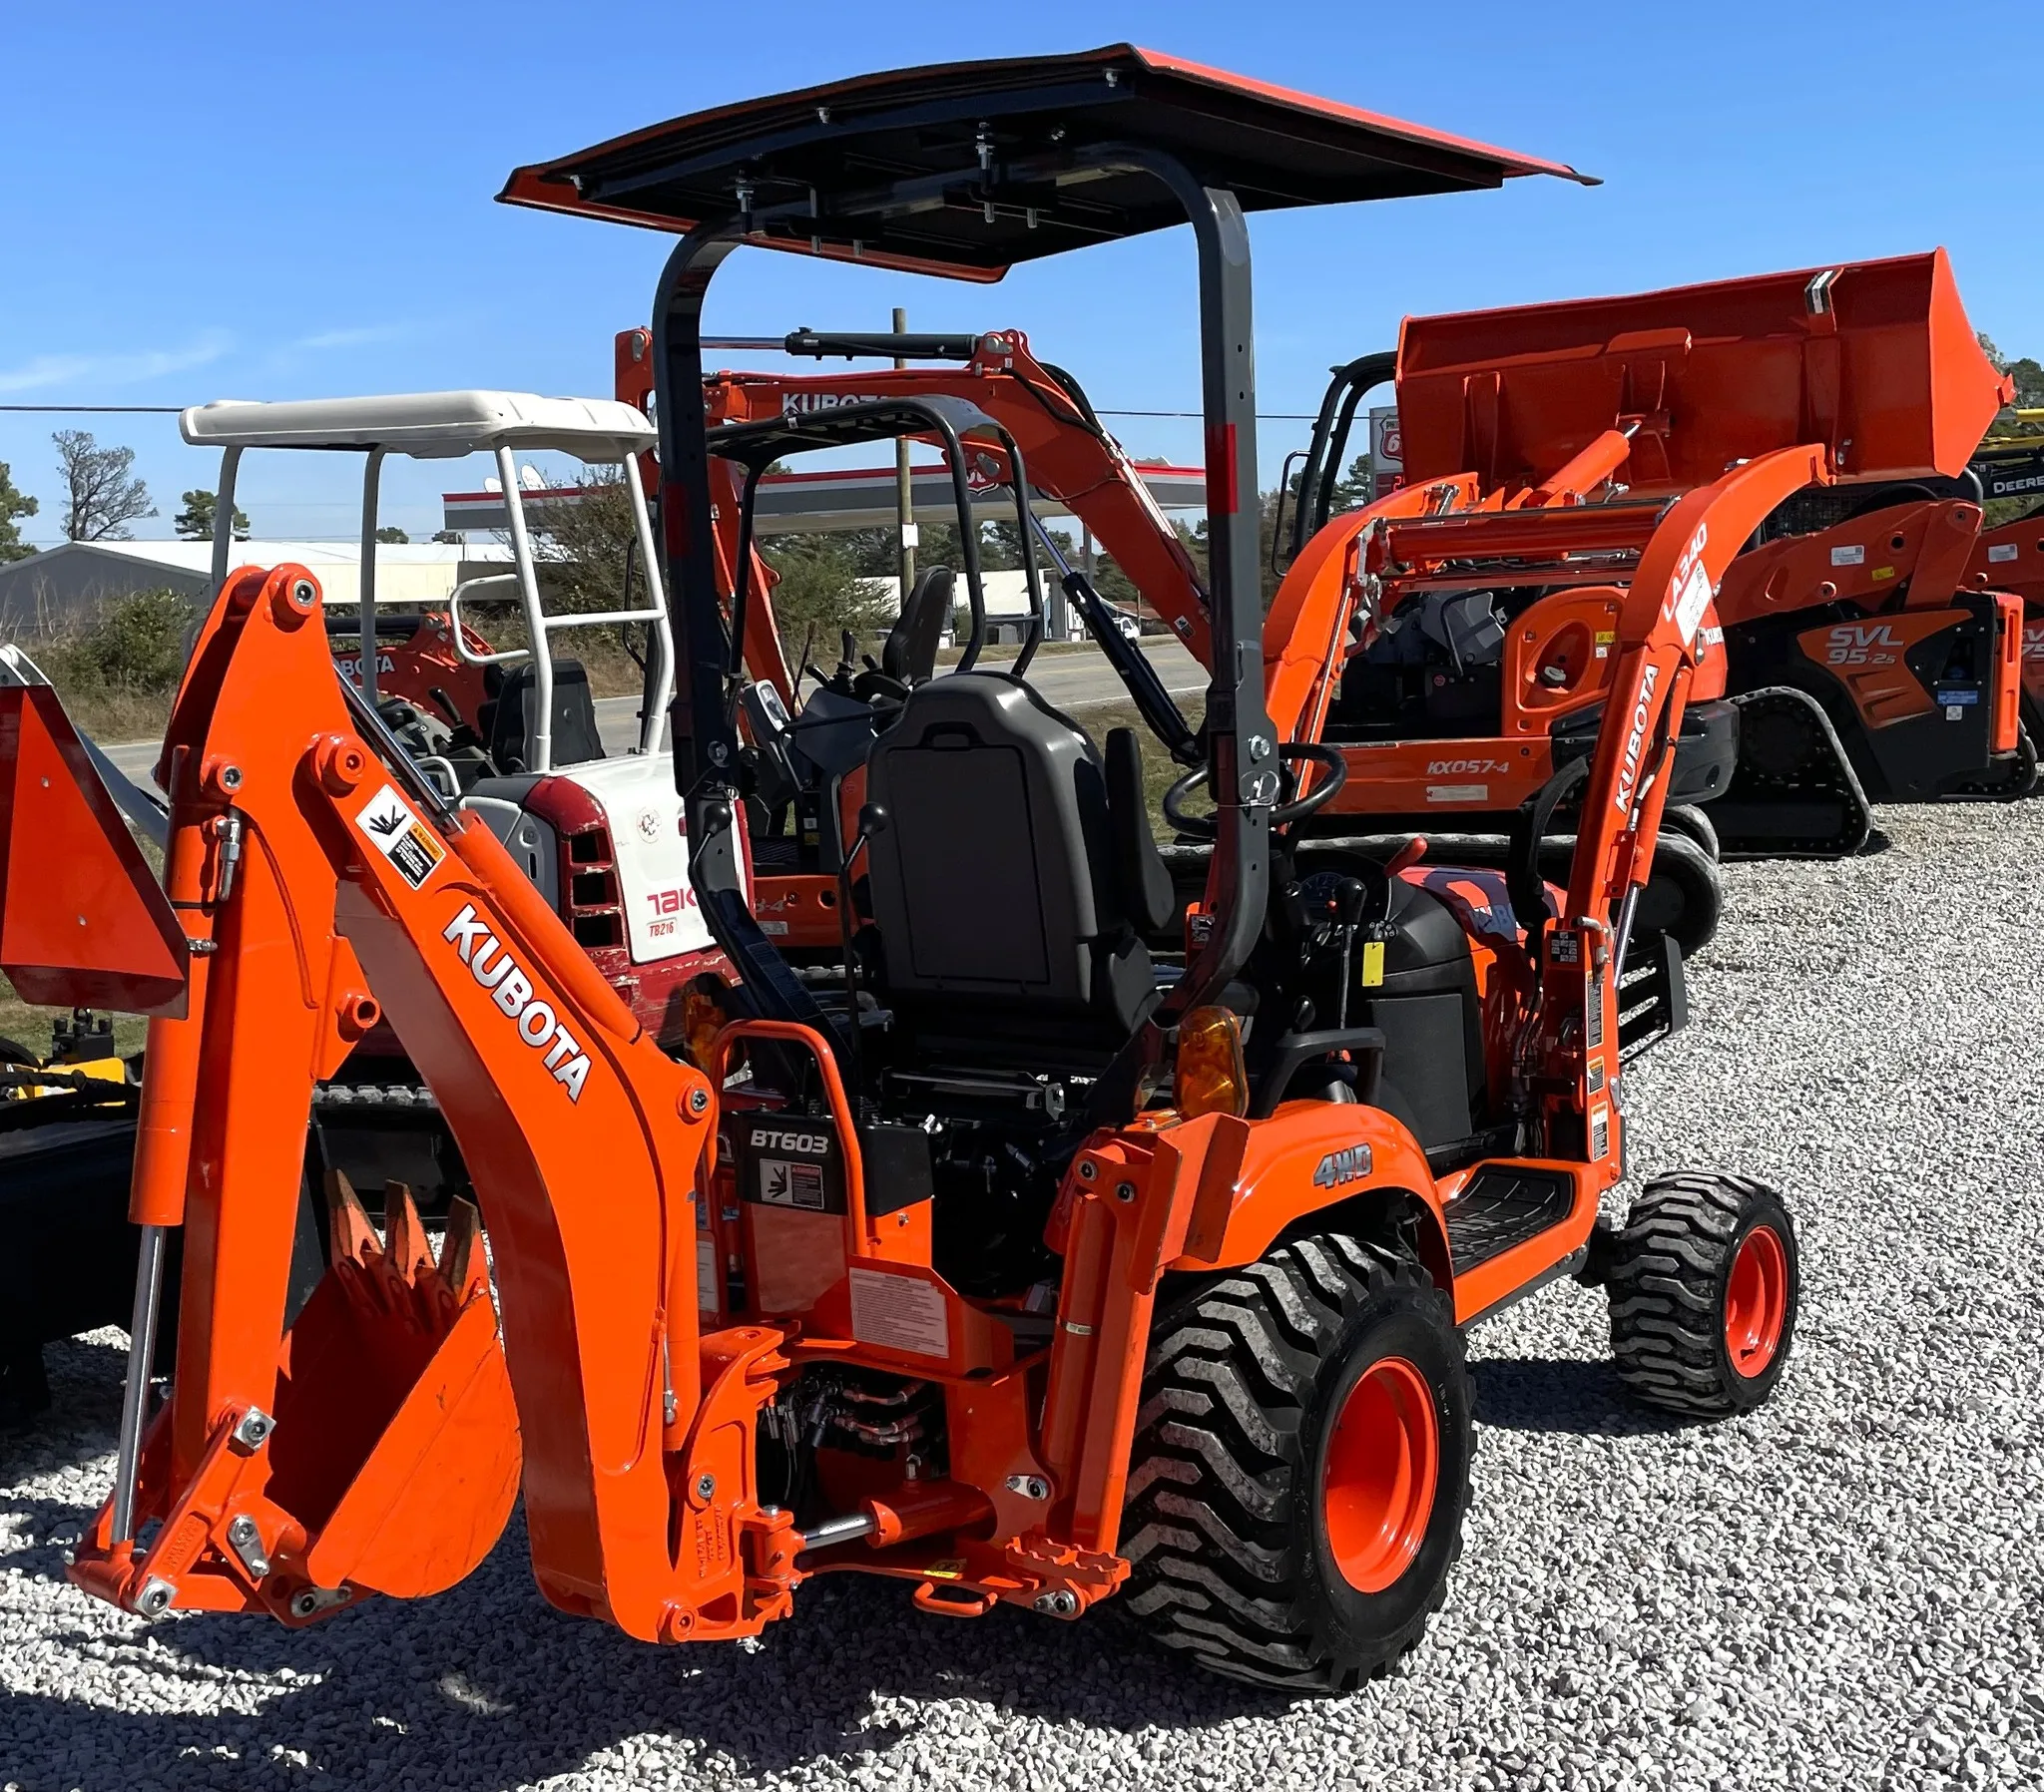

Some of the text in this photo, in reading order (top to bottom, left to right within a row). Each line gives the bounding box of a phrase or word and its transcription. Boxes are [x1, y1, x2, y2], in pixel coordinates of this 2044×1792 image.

[1993, 475, 2044, 494] DEERE
[1664, 523, 1708, 623] LA340
[1825, 626, 1904, 648] SVL
[1615, 663, 1660, 814] KUBOTA
[1426, 759, 1510, 774] KX057-4
[650, 923, 674, 938] TB216
[442, 902, 593, 1106] KUBOTA
[751, 1129, 828, 1154] BT603
[1313, 1142, 1372, 1189] 4WD
